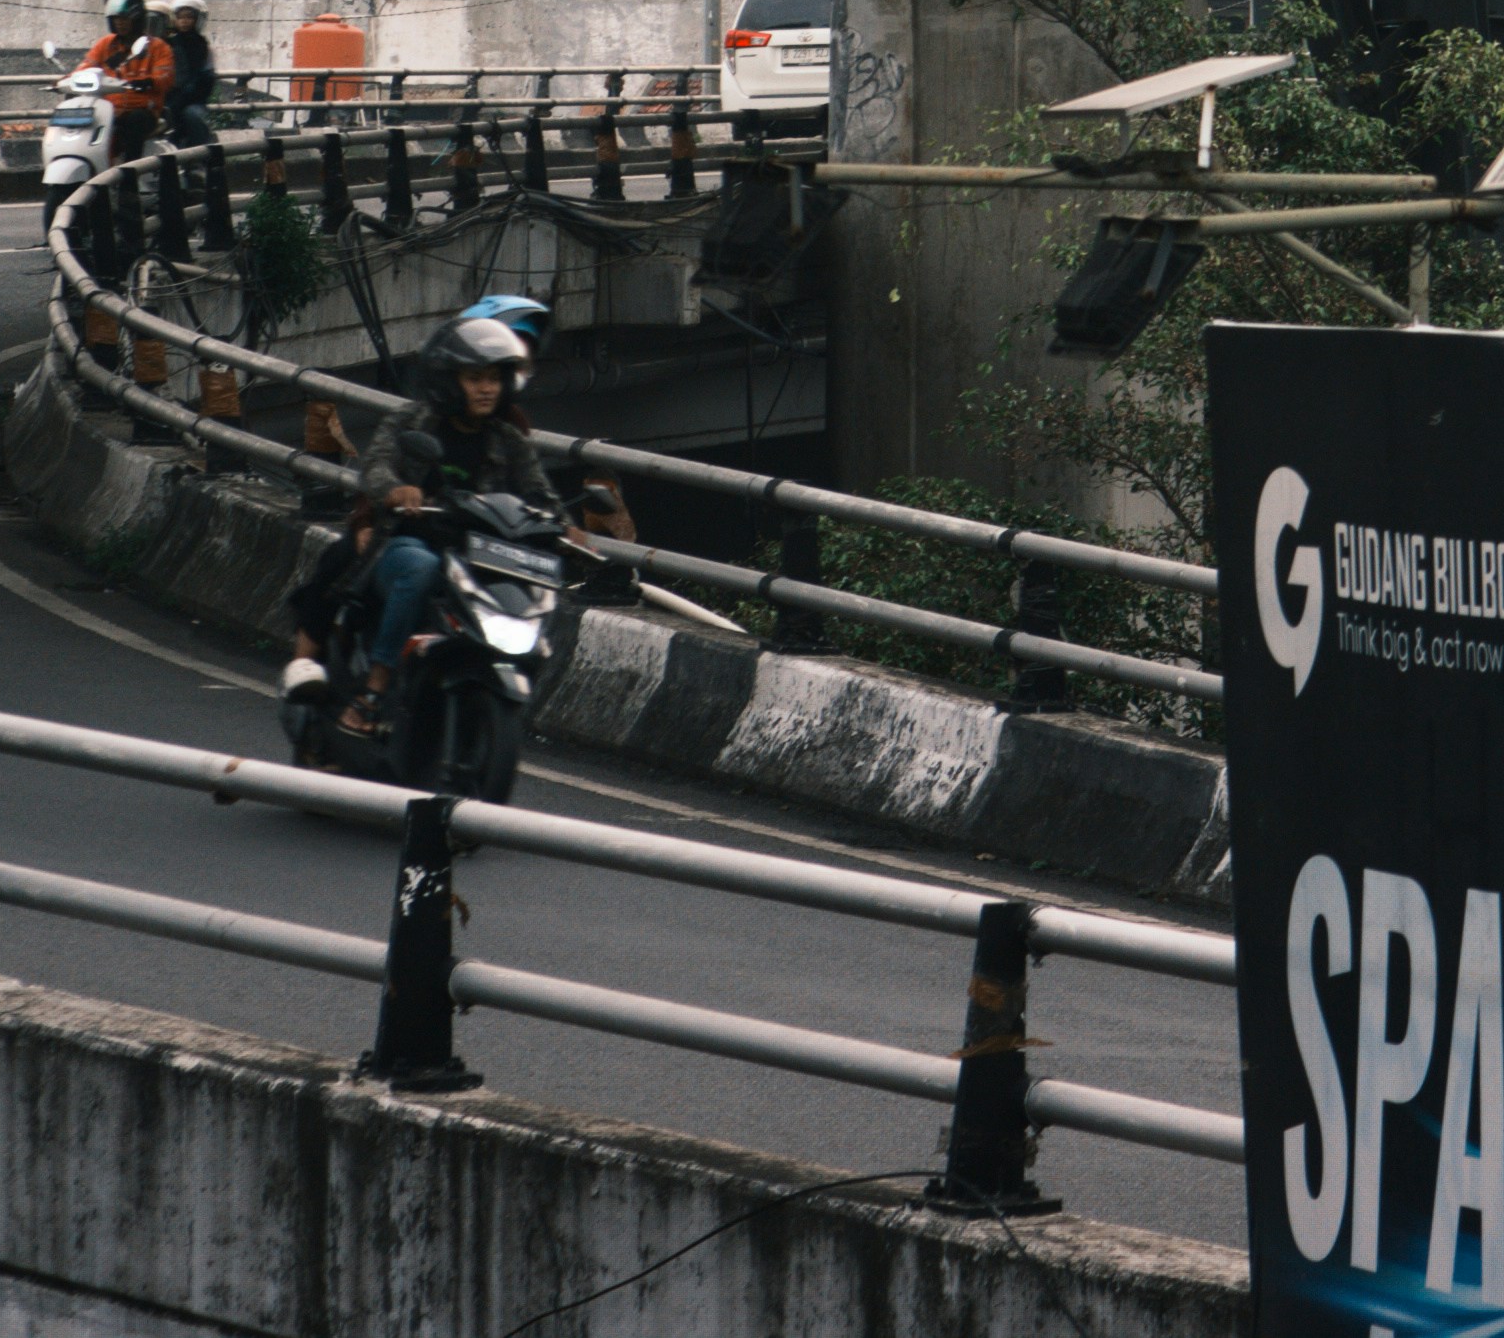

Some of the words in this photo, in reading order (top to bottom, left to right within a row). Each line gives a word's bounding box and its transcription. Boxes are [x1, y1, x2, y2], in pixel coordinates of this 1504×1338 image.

[1334, 522, 1426, 611] GUDANG
[1336, 612, 1378, 658] Think
[1382, 621, 1410, 673] big
[1414, 627, 1427, 665] &
[1432, 629, 1461, 670] act
[1465, 641, 1504, 673] now
